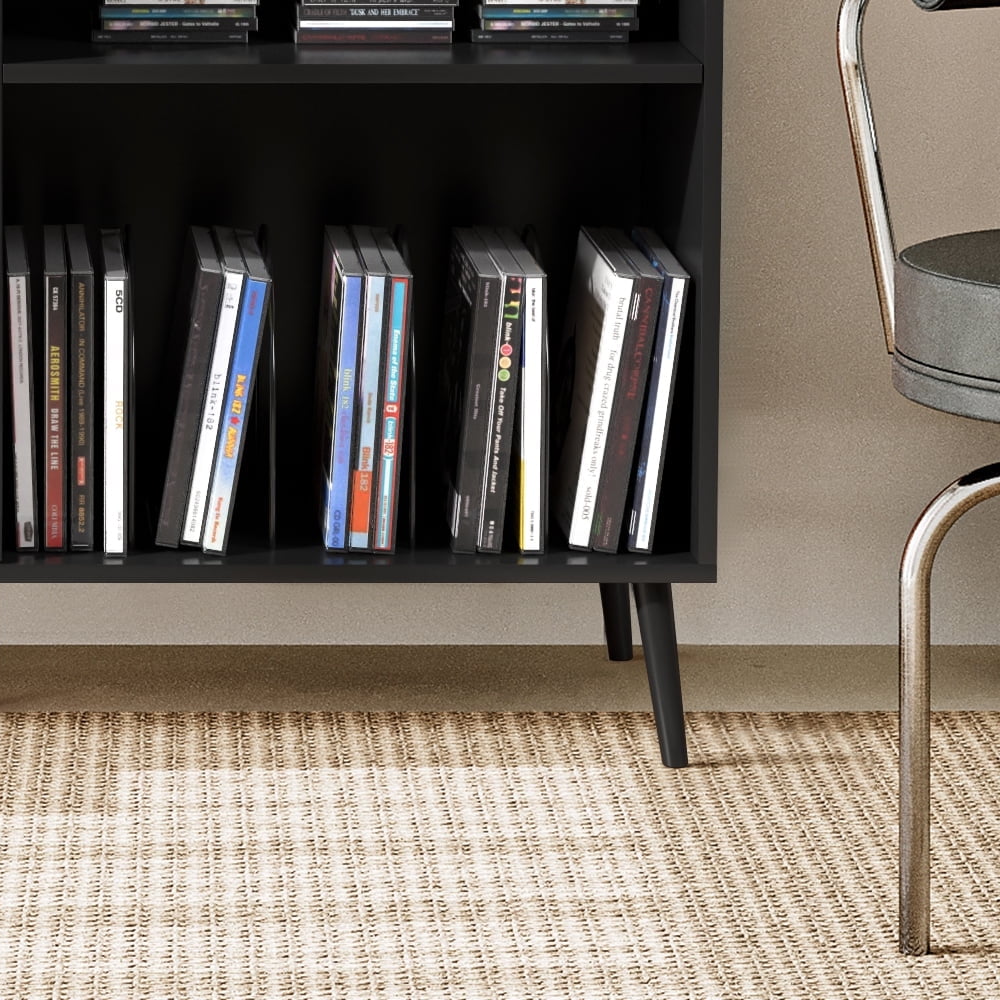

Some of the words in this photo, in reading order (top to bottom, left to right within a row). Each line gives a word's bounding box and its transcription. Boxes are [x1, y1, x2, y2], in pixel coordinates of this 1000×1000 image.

[367, 8, 379, 16] AND
[380, 8, 391, 16] HER
[78, 282, 86, 331] ANNIHILATOR
[115, 289, 123, 313] 5CD
[615, 297, 627, 320] brutal
[79, 338, 86, 346] IN
[391, 329, 401, 355] Enema
[612, 322, 622, 341] truth
[391, 356, 398, 364] of
[608, 350, 617, 361] for
[49, 345, 60, 401] AEROSMITH
[78, 347, 86, 388] COMMAND
[390, 365, 398, 378] the
[603, 363, 616, 381] drug
[342, 368, 353, 392] blink
[389, 380, 398, 402] State
[205, 373, 222, 431] blink-182
[499, 387, 507, 404] Take
[600, 383, 611, 409] crazed
[50, 408, 59, 432] DRAW
[115, 400, 123, 430] ROCK
[495, 417, 503, 433] Your
[50, 435, 59, 449] THE
[592, 410, 608, 455] grindfreaks
[493, 434, 502, 454] Pants
[50, 452, 59, 471] LINE
[360, 446, 371, 471] Blink
[492, 455, 500, 471] And
[359, 472, 369, 492] 182
[490, 471, 498, 494] Jacket
[581, 486, 593, 520] sold-005
[333, 509, 341, 520] CD
[210, 521, 220, 544] Records
